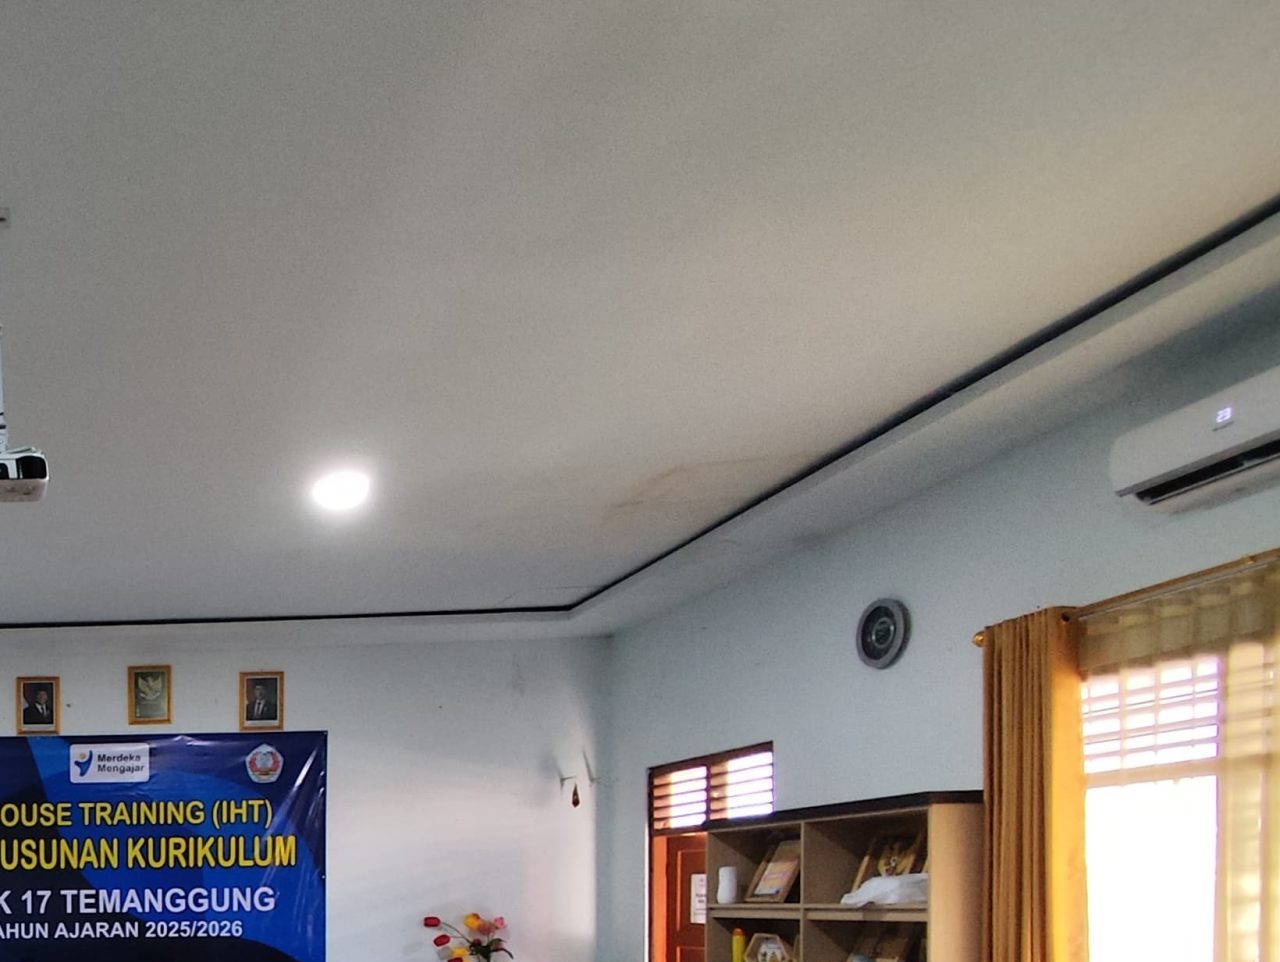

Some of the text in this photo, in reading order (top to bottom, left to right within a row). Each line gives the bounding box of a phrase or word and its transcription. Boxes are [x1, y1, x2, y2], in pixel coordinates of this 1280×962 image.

[97, 753, 141, 763] Merdeka
[97, 764, 144, 774] Mengajar
[79, 801, 205, 825] TRAINING
[212, 799, 272, 829] (IHT)
[127, 835, 295, 868] KURIKULUM
[21, 890, 52, 914] 17
[60, 886, 276, 914] TEMANGGUNG
[54, 921, 139, 939] AJARAN
[145, 920, 243, 938] 2025/2026
